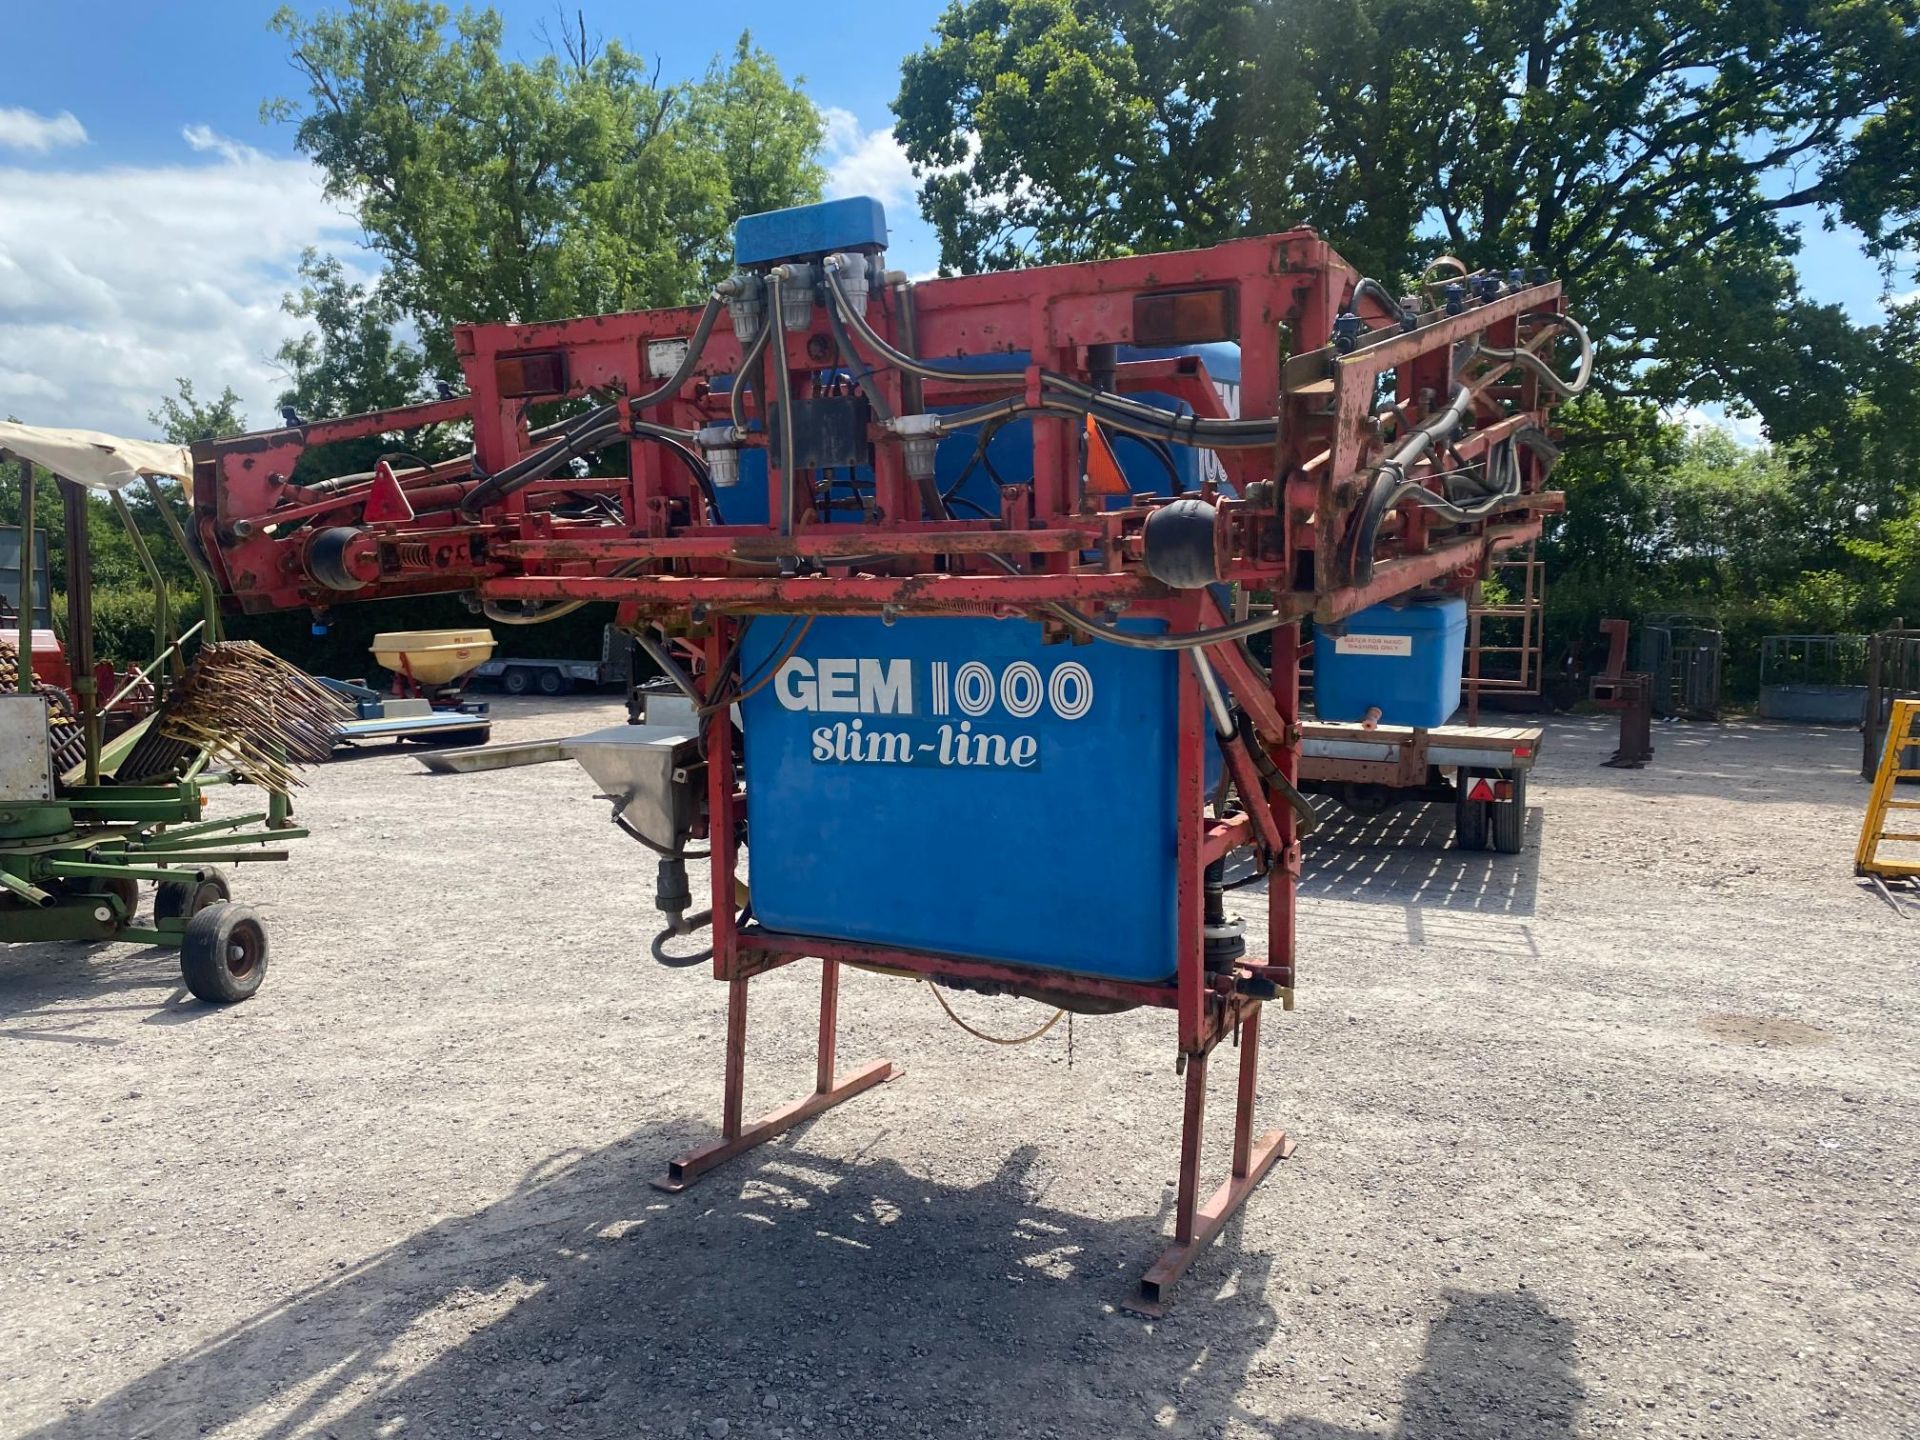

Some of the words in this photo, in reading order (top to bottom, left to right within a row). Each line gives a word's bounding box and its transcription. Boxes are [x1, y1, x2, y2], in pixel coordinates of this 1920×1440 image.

[774, 656, 913, 714] GEM
[931, 660, 1094, 720] 1000
[811, 718, 1038, 768] slim-line
